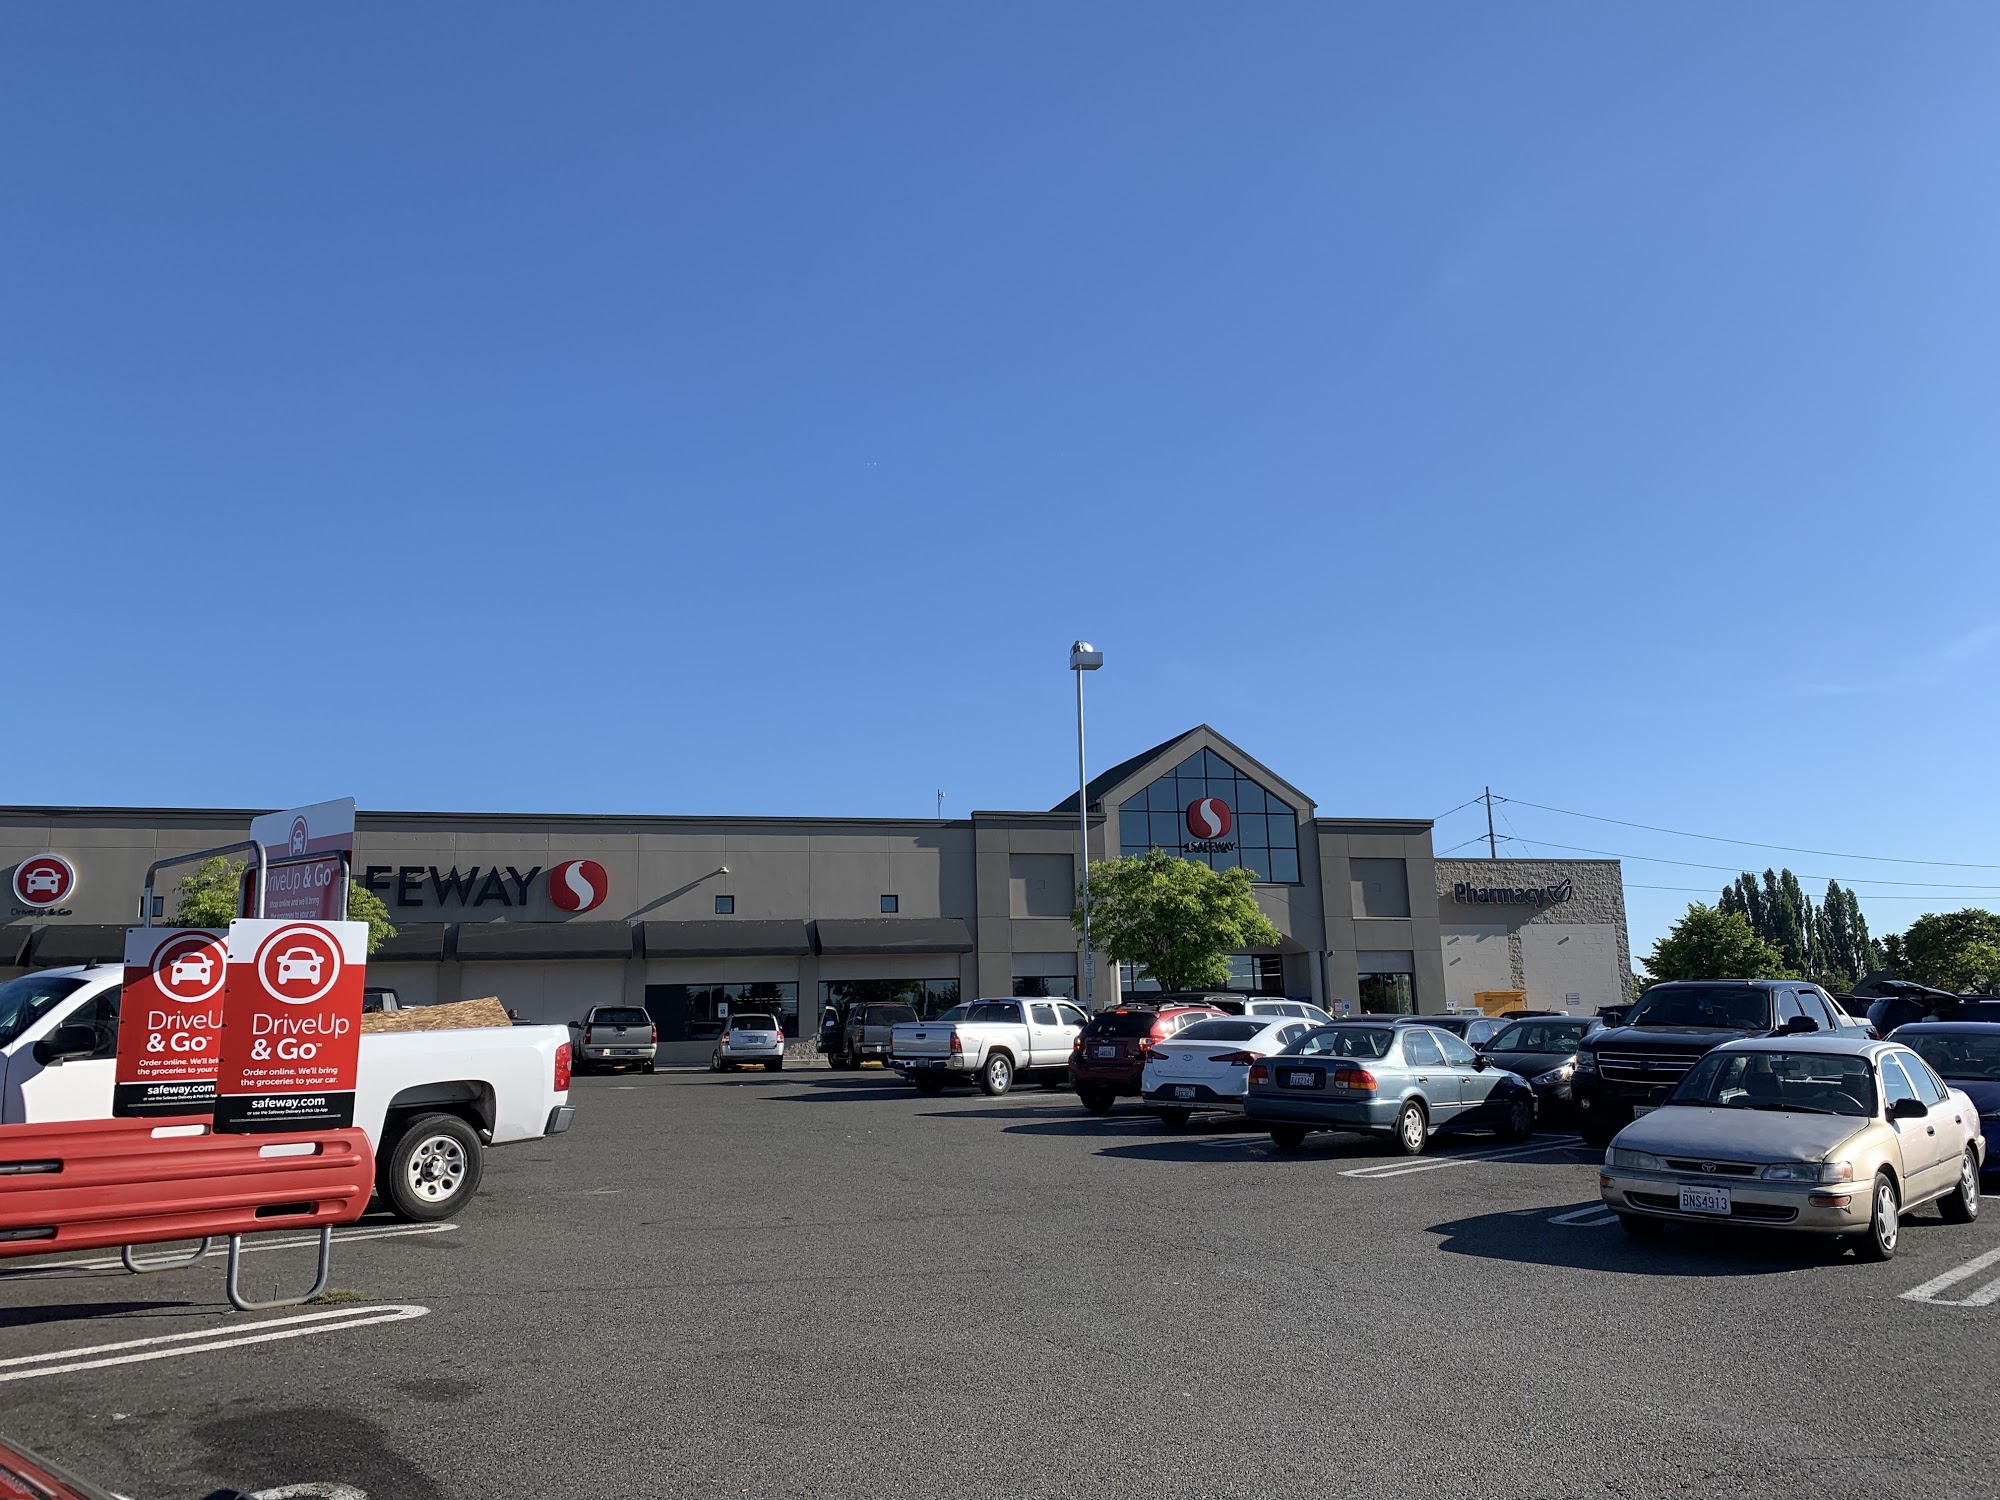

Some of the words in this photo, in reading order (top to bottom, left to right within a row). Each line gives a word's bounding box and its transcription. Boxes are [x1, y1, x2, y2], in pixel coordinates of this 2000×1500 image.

[303, 865, 311, 888] &
[366, 865, 542, 907] FEWAY
[309, 897, 319, 906] bring
[1454, 882, 1545, 908] Pharmacy
[10, 908, 46, 919] DriveUp
[48, 908, 55, 916] &
[58, 908, 72, 916] Go
[300, 912, 309, 920] your
[148, 1010, 223, 1030] DriveU
[252, 1012, 349, 1039] DriveUp
[146, 1033, 166, 1052] &
[250, 1038, 272, 1060] &
[151, 1068, 186, 1076] groceries
[242, 1068, 267, 1076] Order
[270, 1067, 296, 1075] online.
[318, 1066, 337, 1076] bring
[256, 1078, 294, 1087] groceries
[306, 1078, 323, 1086] your
[147, 1085, 214, 1096] safeway.com
[252, 1097, 325, 1109] safeway.com
[1682, 1194, 1727, 1210] BNS4913
